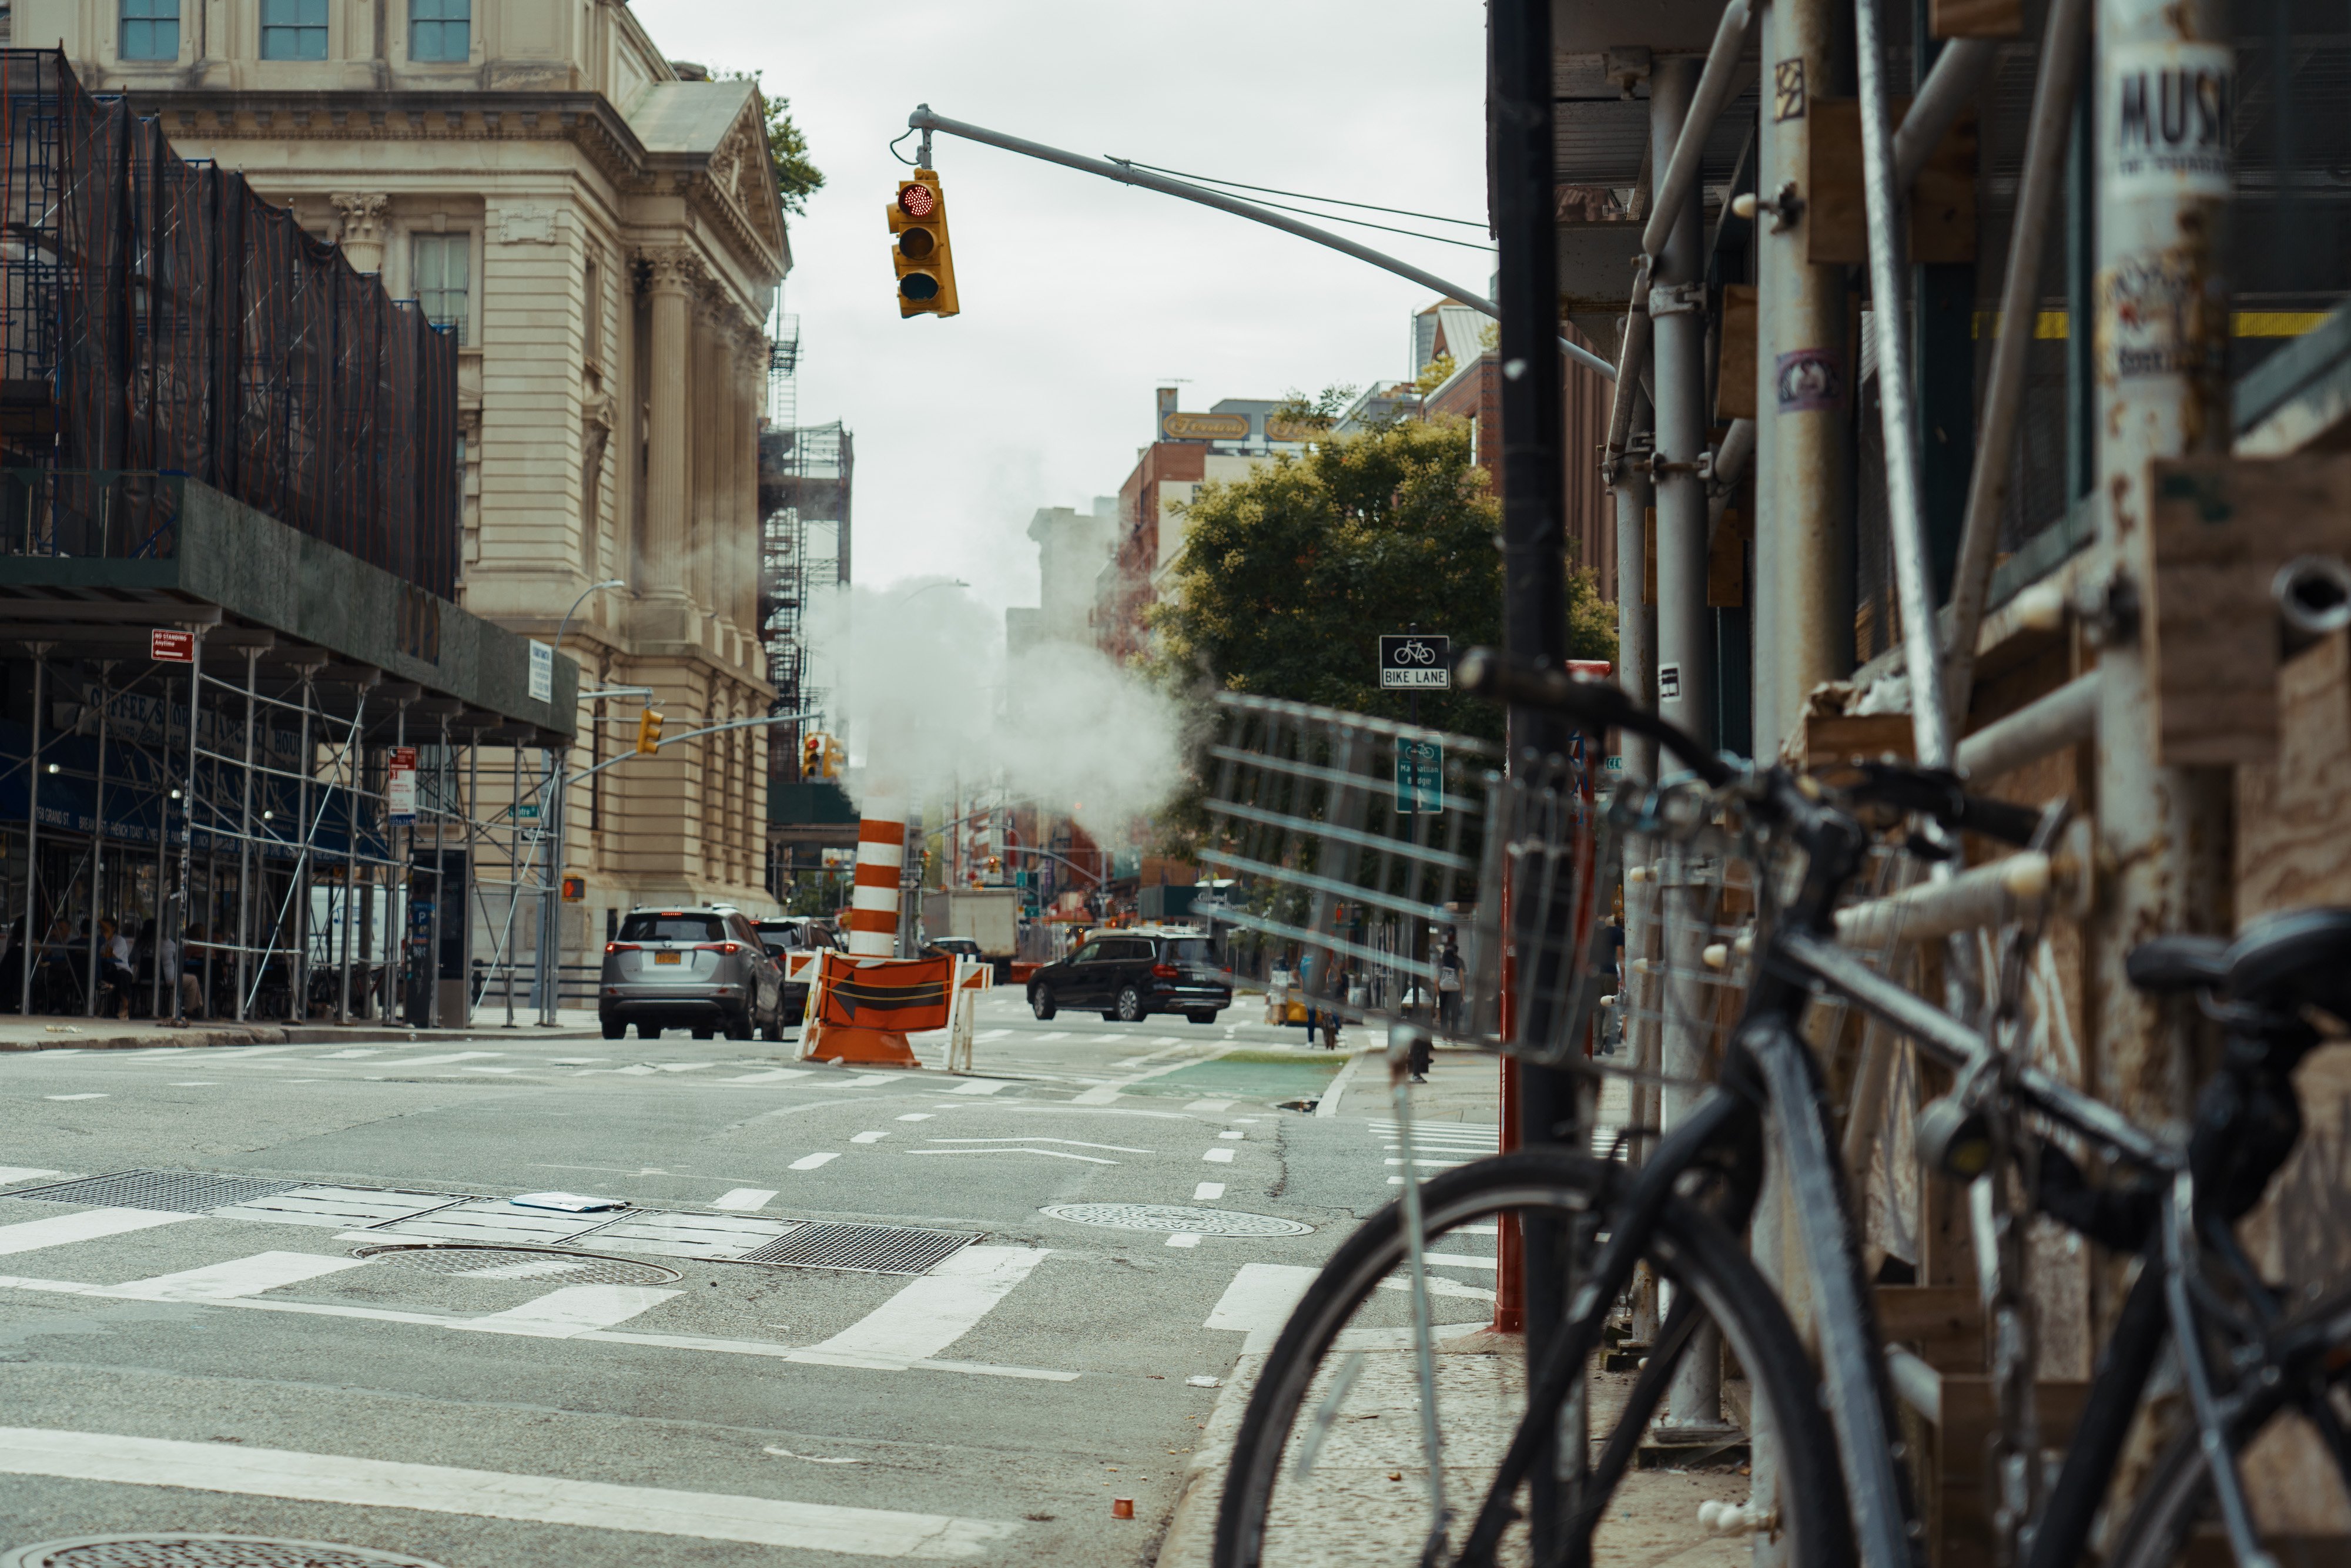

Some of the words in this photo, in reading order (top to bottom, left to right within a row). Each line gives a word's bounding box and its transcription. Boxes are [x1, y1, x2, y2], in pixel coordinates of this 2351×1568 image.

[163, 634, 187, 642] STANDING
[1385, 671, 1409, 682] BIKE
[1416, 671, 1445, 682] LANE
[45, 808, 63, 823] GRAND
[418, 912, 426, 923] P
